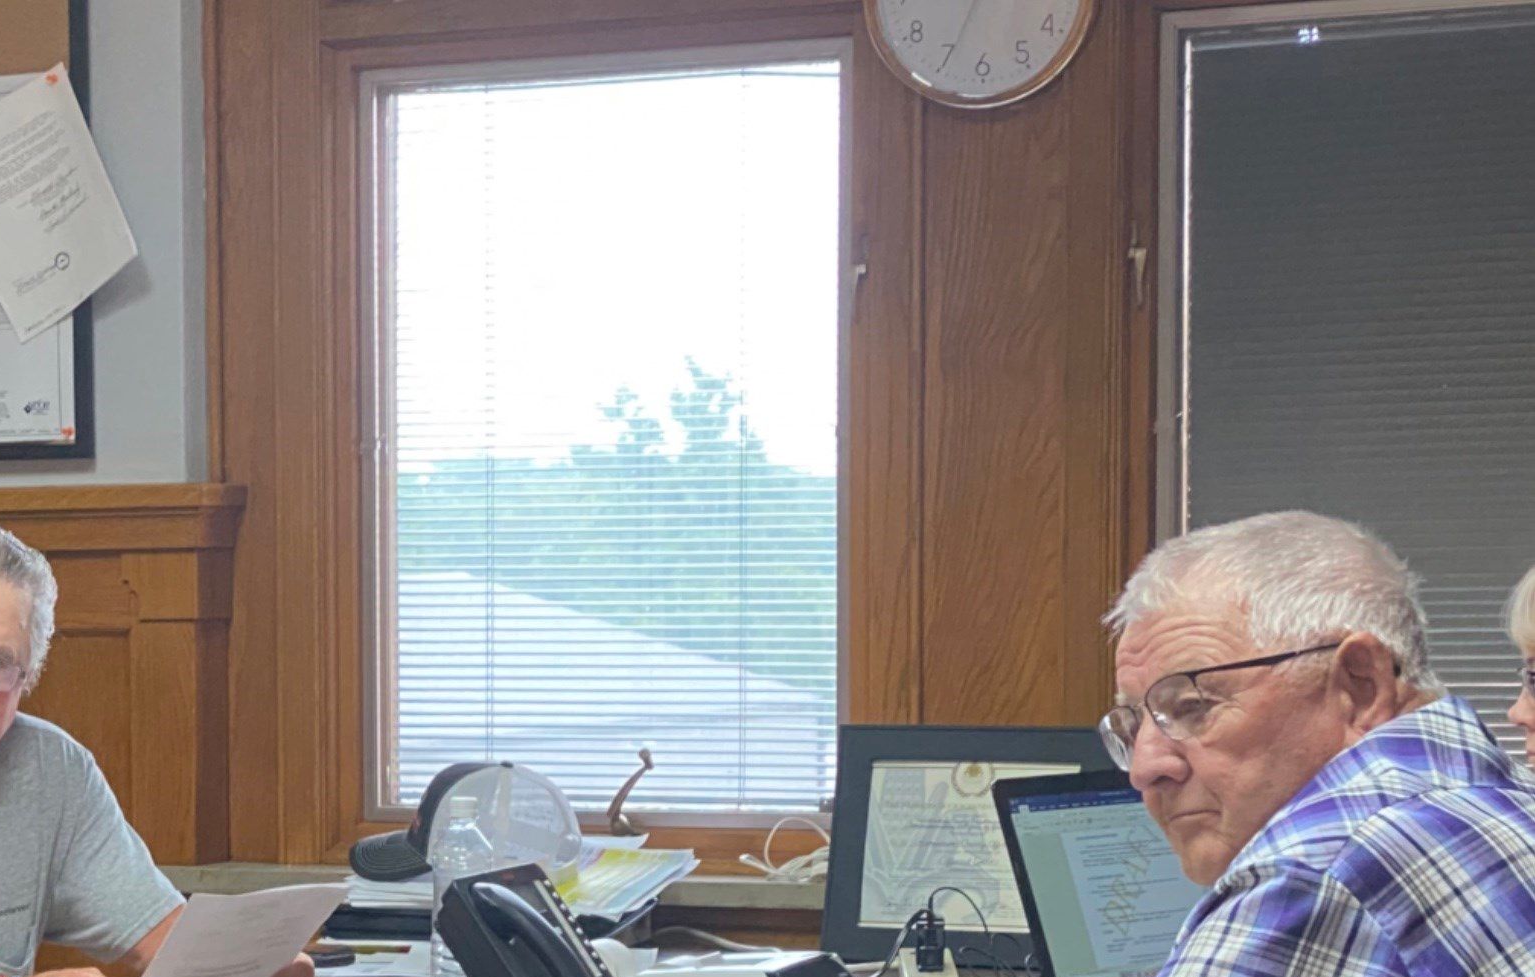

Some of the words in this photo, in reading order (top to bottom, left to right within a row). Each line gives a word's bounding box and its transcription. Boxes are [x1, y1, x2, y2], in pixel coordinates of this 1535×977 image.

[909, 20, 923, 43] 8
[1040, 13, 1055, 37] 4
[938, 43, 956, 69] 7
[1015, 40, 1030, 64] 5
[975, 52, 990, 77] 6
